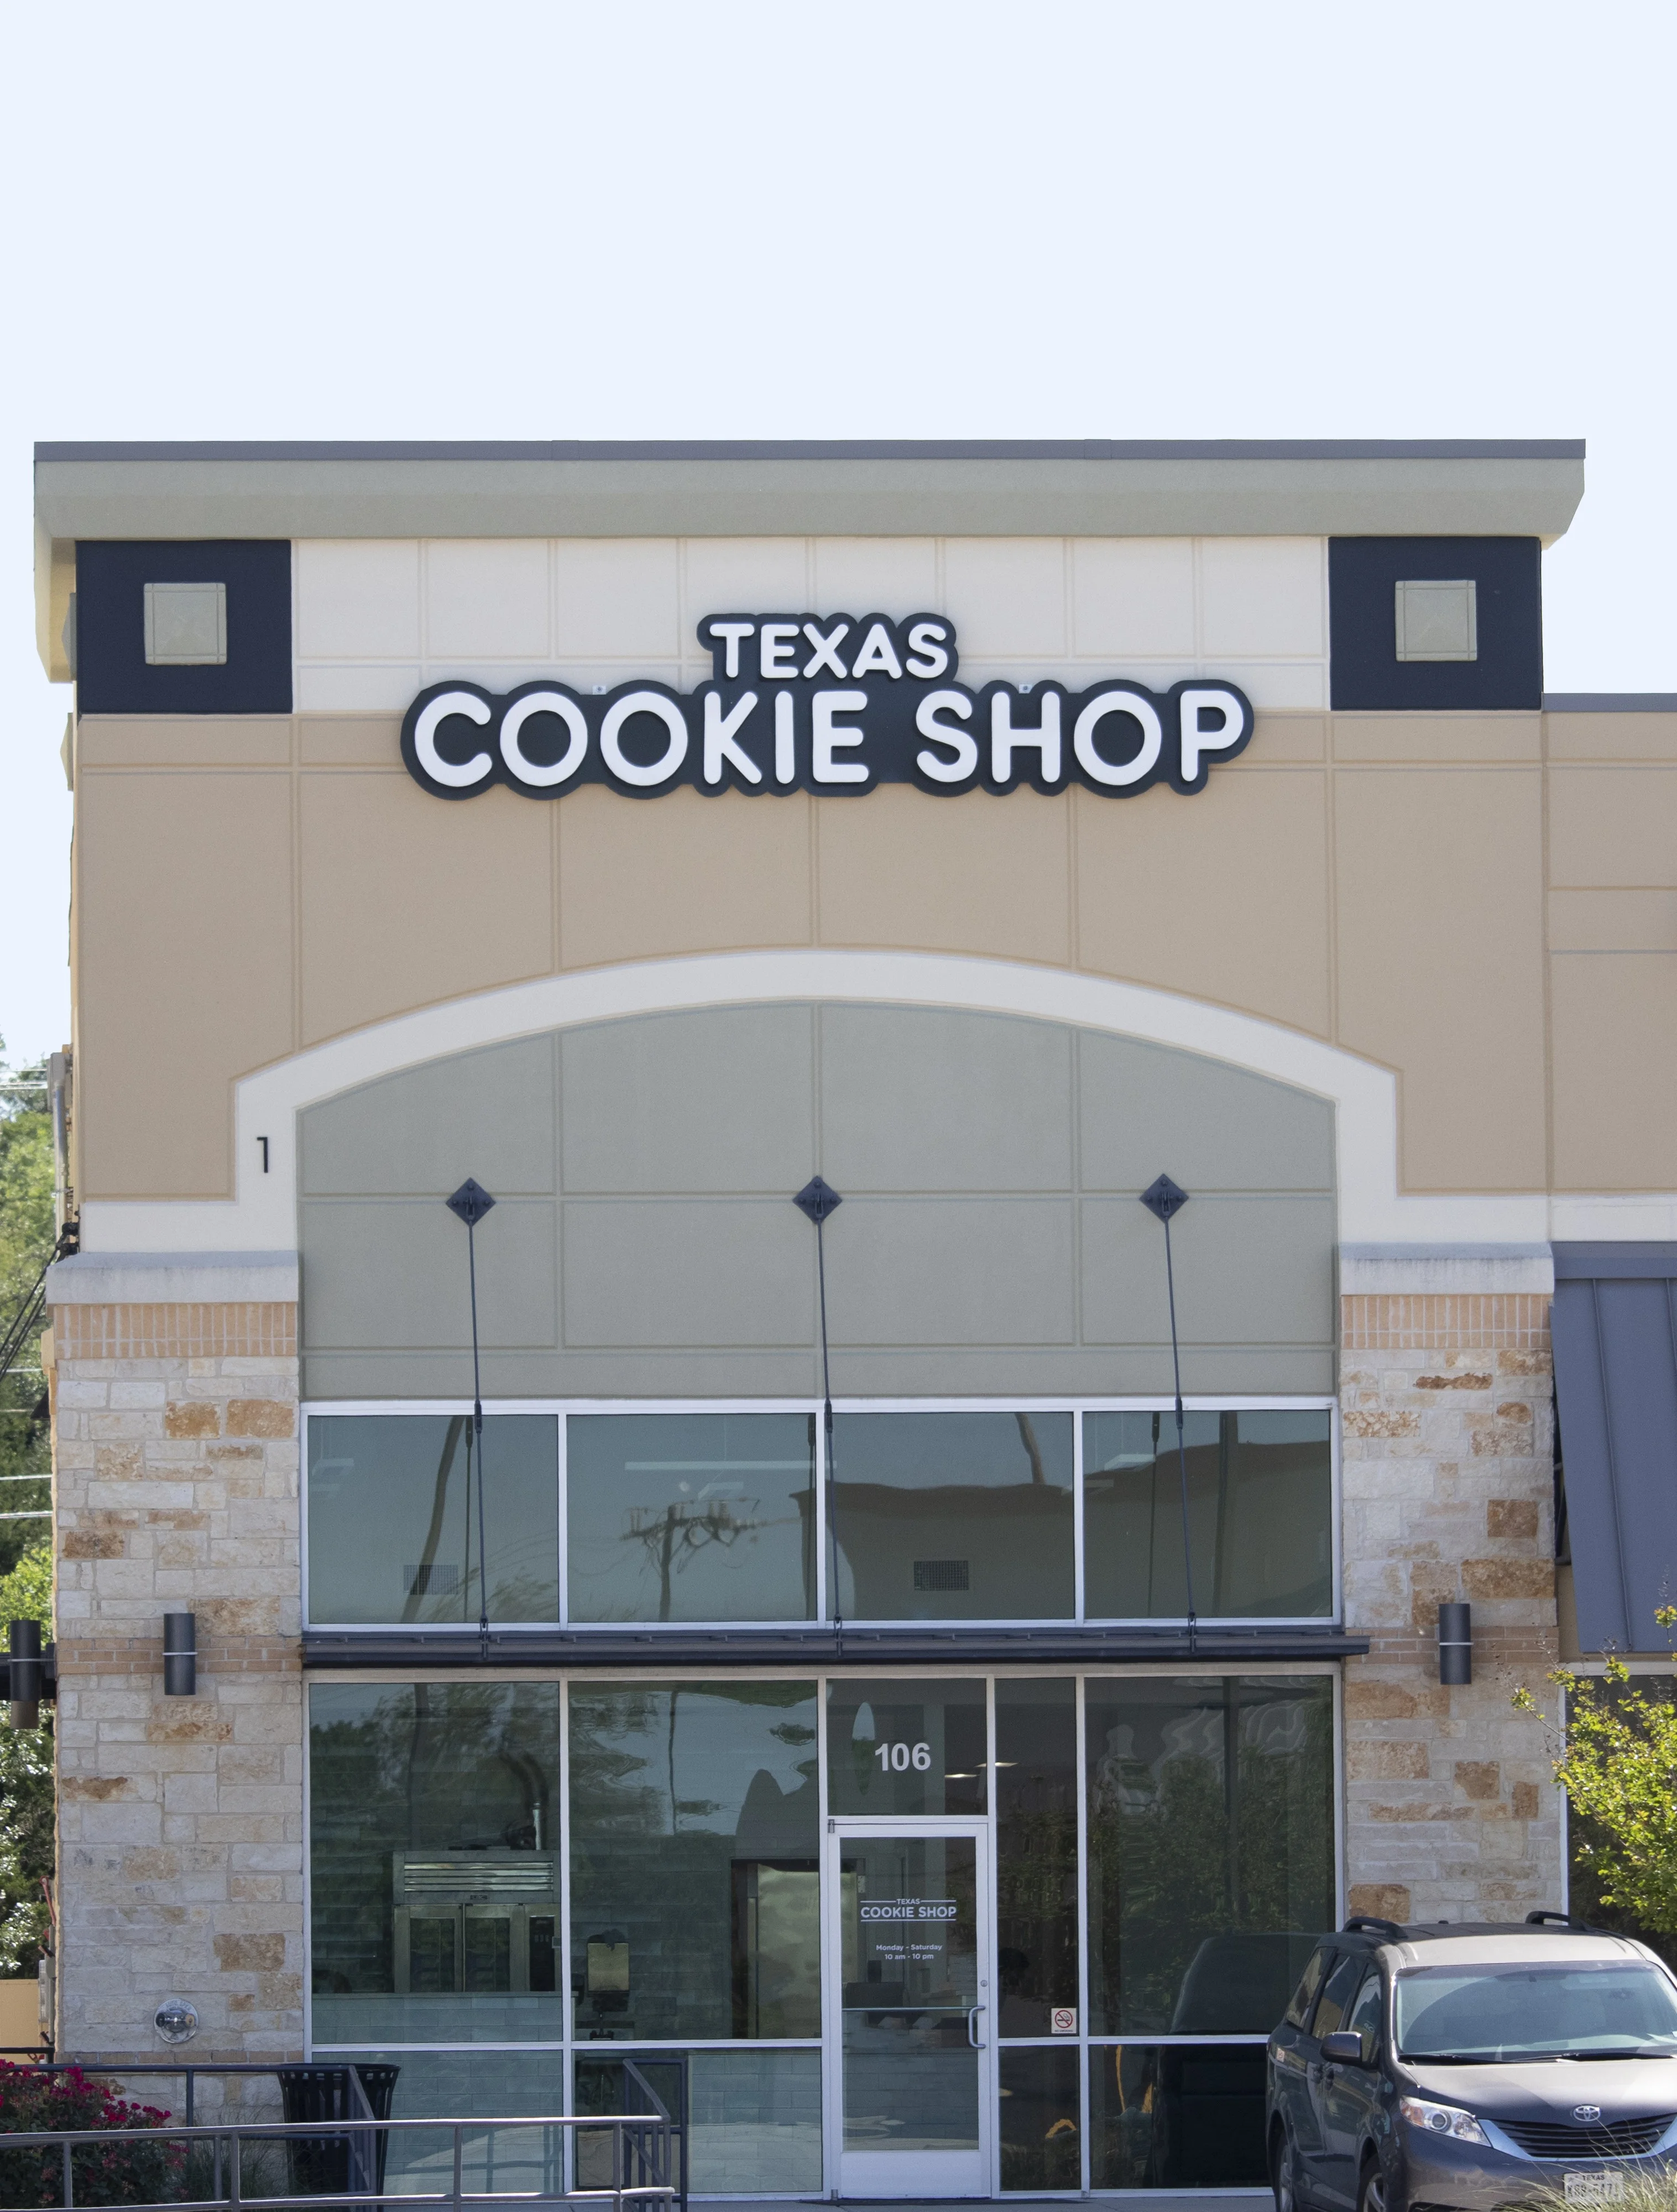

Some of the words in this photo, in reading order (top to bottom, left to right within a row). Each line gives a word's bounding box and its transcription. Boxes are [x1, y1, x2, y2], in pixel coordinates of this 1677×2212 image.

[710, 623, 948, 678] TEXAS
[414, 691, 869, 787] COOKIE
[916, 691, 1244, 786] SHOP
[257, 1136, 269, 1173] 1
[875, 1743, 931, 1771] 106
[860, 1907, 915, 1918] COOKIE
[918, 1906, 957, 1918] SHOP
